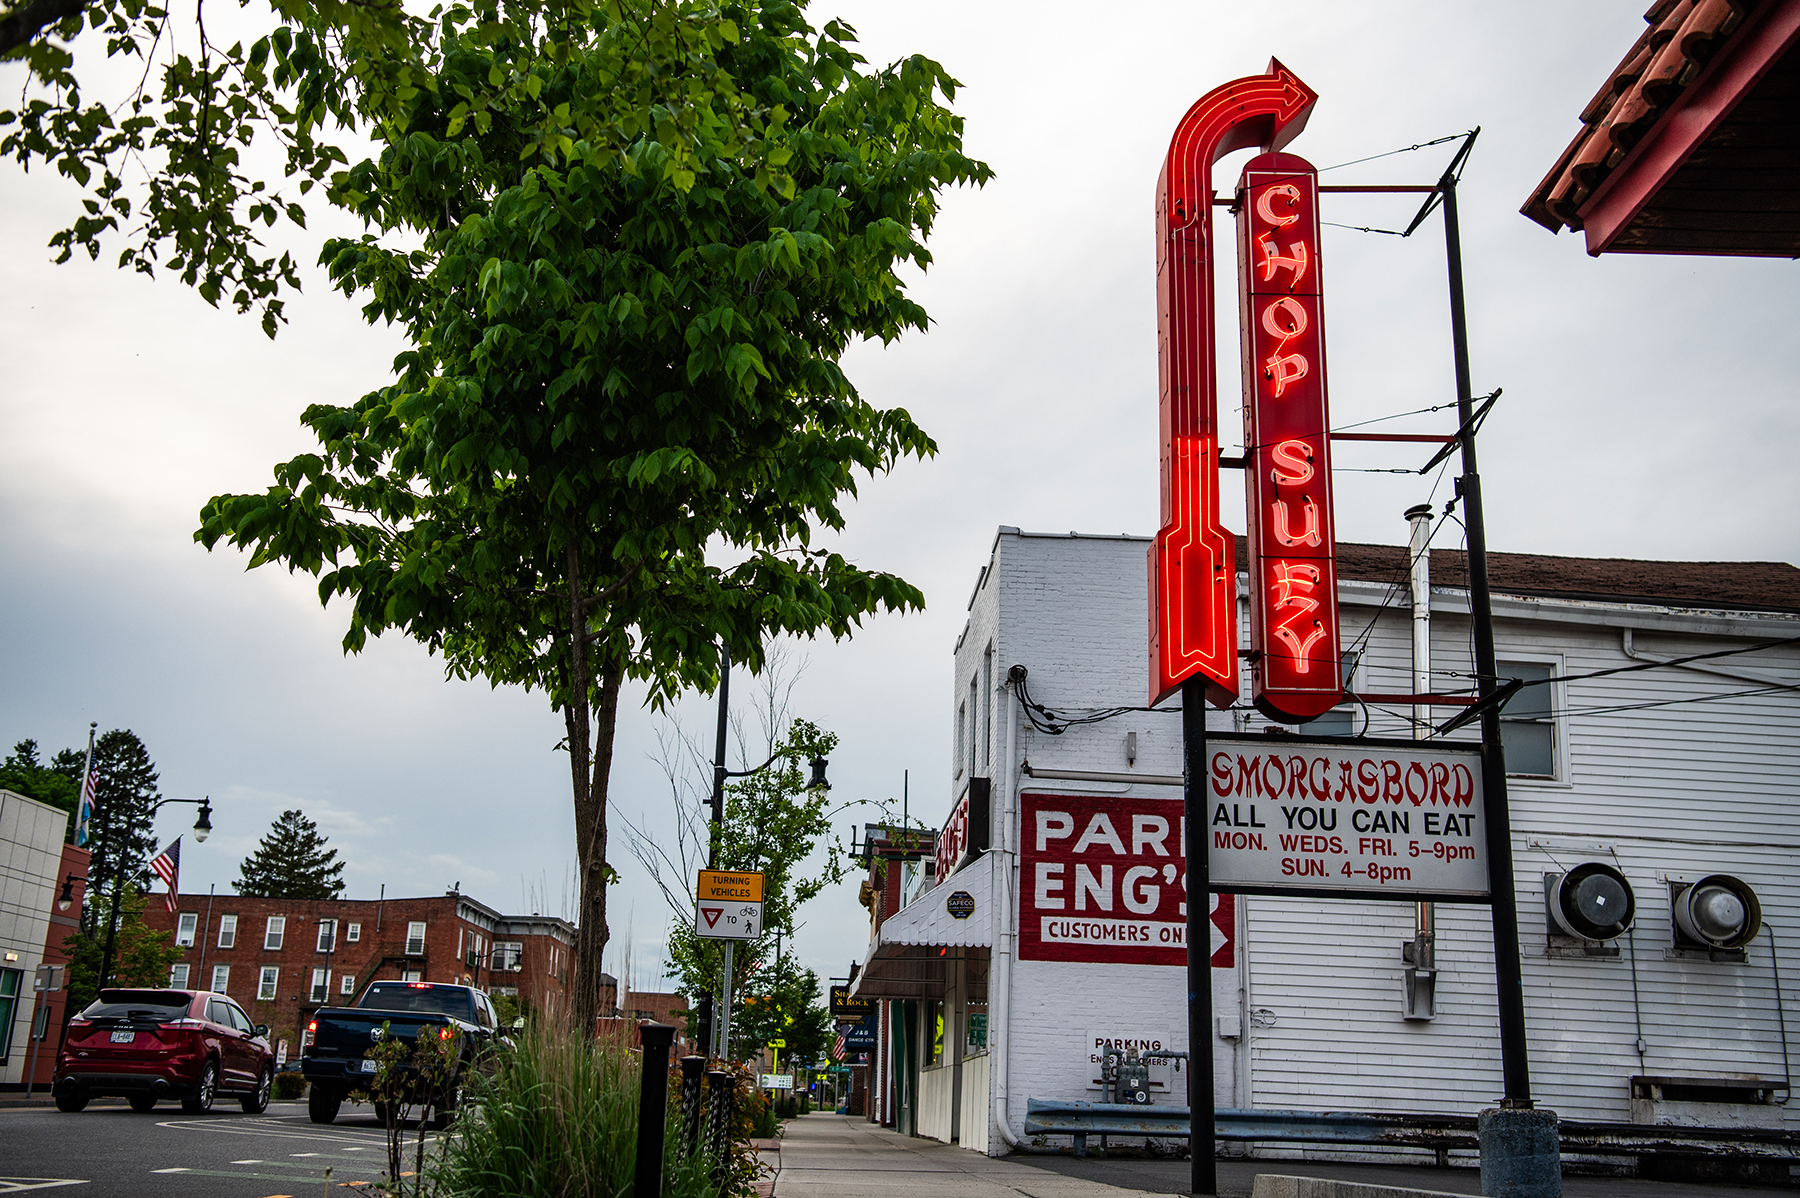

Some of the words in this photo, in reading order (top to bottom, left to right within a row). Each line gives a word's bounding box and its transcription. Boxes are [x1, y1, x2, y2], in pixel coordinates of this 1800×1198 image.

[1256, 184, 1309, 398] CHOP
[1270, 440, 1328, 674] SUEY
[1211, 751, 1474, 808] SMORGASBORD
[1212, 803, 1266, 828] ALL
[1280, 806, 1337, 831] YOU
[1352, 809, 1410, 834] CAN
[1424, 812, 1476, 837] EAT
[1035, 809, 1187, 858] PAR
[1214, 831, 1268, 851] MON.
[1278, 834, 1348, 855] WEDS.
[1359, 837, 1398, 857] FRI.
[1281, 858, 1330, 877] SUN.
[713, 876, 750, 885] TURNING
[711, 888, 751, 897] VEHICLES
[726, 916, 737, 924] TO
[1048, 921, 1150, 942] CUSTOMERS
[1159, 926, 1188, 944] ON
[836, 998, 844, 1006] &
[1095, 1038, 1161, 1051] PARKING
